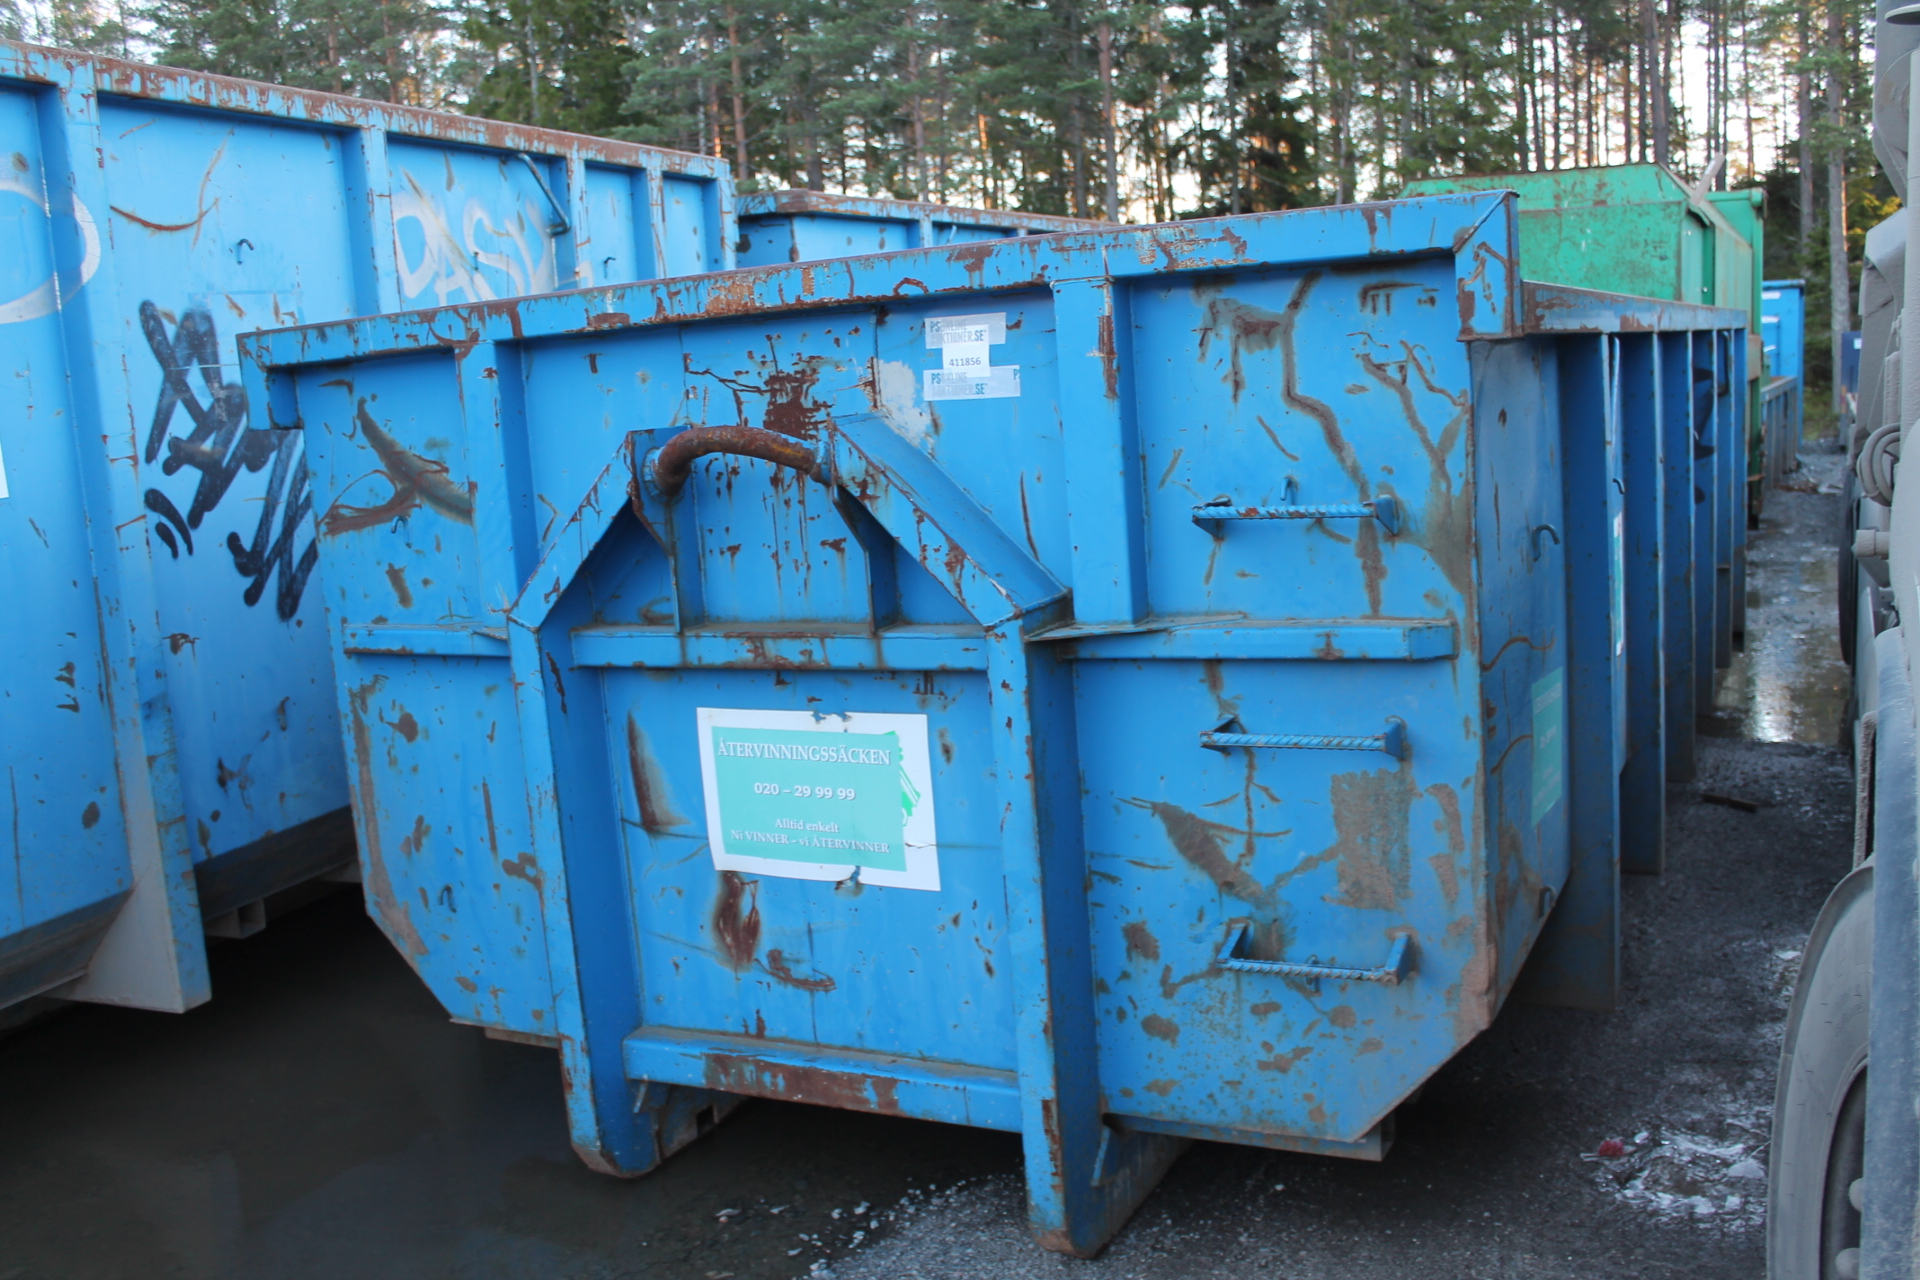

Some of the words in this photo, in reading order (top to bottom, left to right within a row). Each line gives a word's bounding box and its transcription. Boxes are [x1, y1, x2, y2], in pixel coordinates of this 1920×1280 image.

[949, 357, 982, 367] 411856
[718, 738, 891, 766] ÅTERVINNINGSSÄCKEN
[754, 782, 780, 796] 020
[794, 785, 812, 798] 29
[815, 787, 833, 799] 99
[837, 788, 856, 801] 99
[775, 818, 804, 831] Alltid
[806, 822, 840, 834] enkelt
[730, 830, 744, 841] Ni
[745, 831, 790, 845] VINNER
[799, 836, 810, 847] vi
[812, 835, 890, 854] ÅTERVINNER
